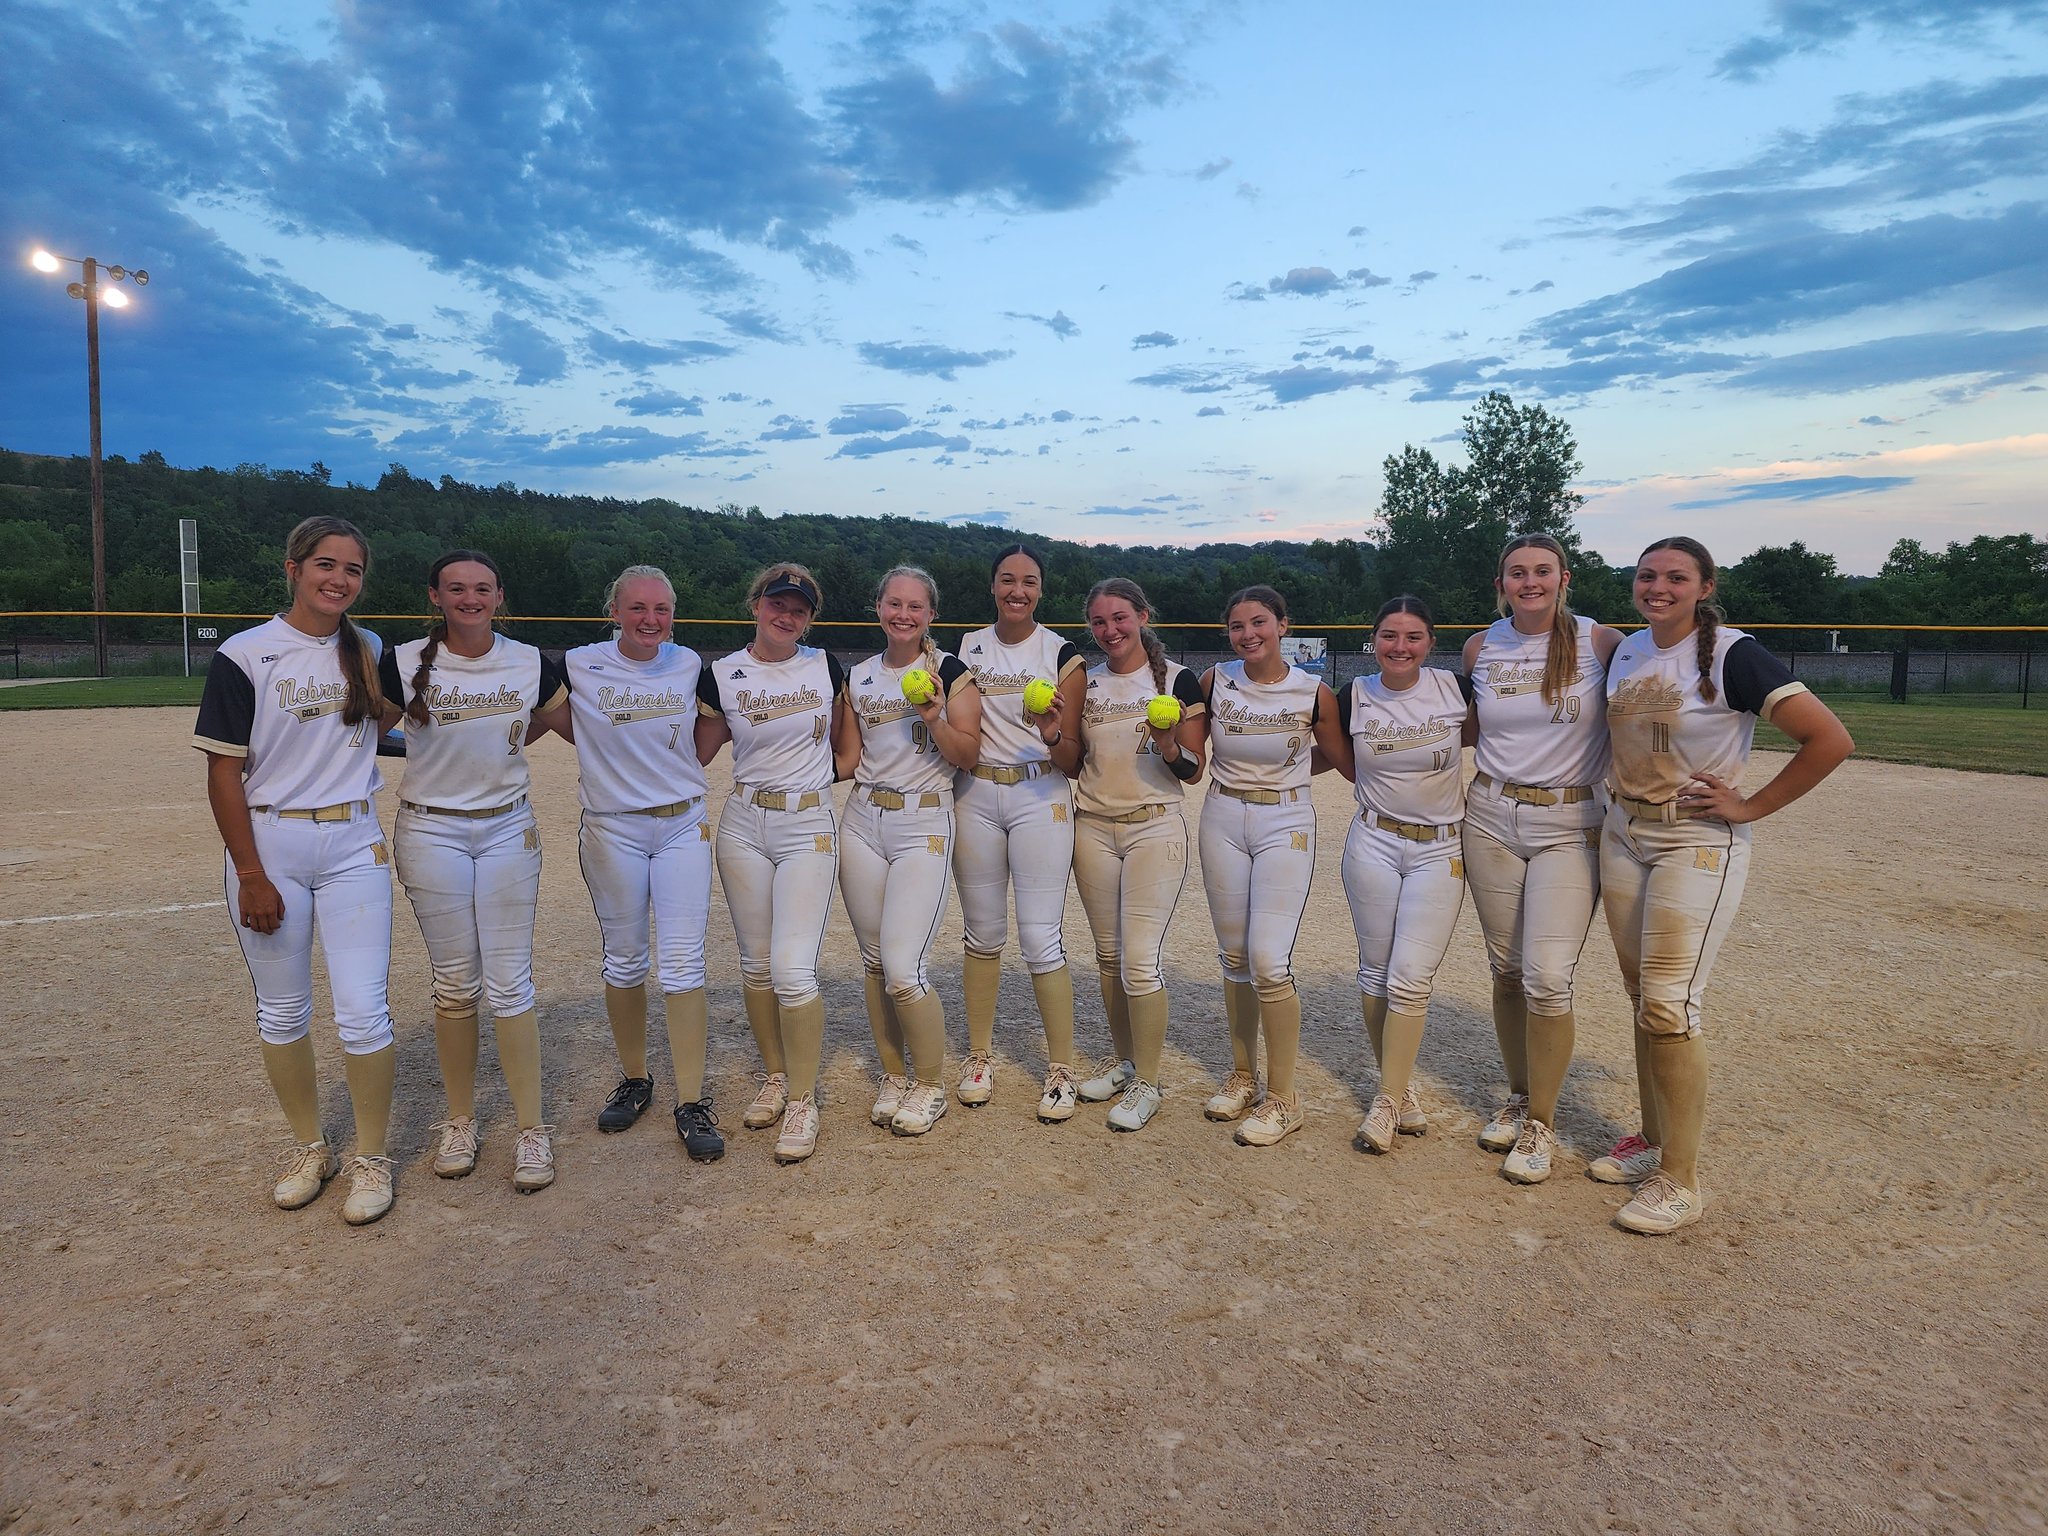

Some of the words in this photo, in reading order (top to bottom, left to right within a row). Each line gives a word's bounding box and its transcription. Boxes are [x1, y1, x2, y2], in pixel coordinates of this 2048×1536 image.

[199, 629, 216, 638] 200
[275, 676, 350, 708] Nebras
[424, 684, 521, 709] Nebraska
[598, 687, 684, 710] Nebraska
[736, 685, 820, 713] Nebraska
[860, 694, 911, 714] Nebras
[302, 708, 320, 717] GOLD
[753, 713, 768, 721] GOLD
[1218, 699, 1297, 725] Nebraska
[1549, 696, 1580, 723] 29
[508, 720, 523, 755] 9
[668, 724, 680, 749] 7
[1364, 715, 1448, 740] Nebraska
[1652, 722, 1669, 752] 11
[1284, 737, 1300, 767] 2
[1432, 747, 1452, 771] 17
[1051, 803, 1068, 823] N
[814, 834, 832, 854] N
[927, 835, 945, 855] N
[1167, 841, 1183, 861] N
[1290, 831, 1308, 852] N
[1693, 848, 1721, 872] N
